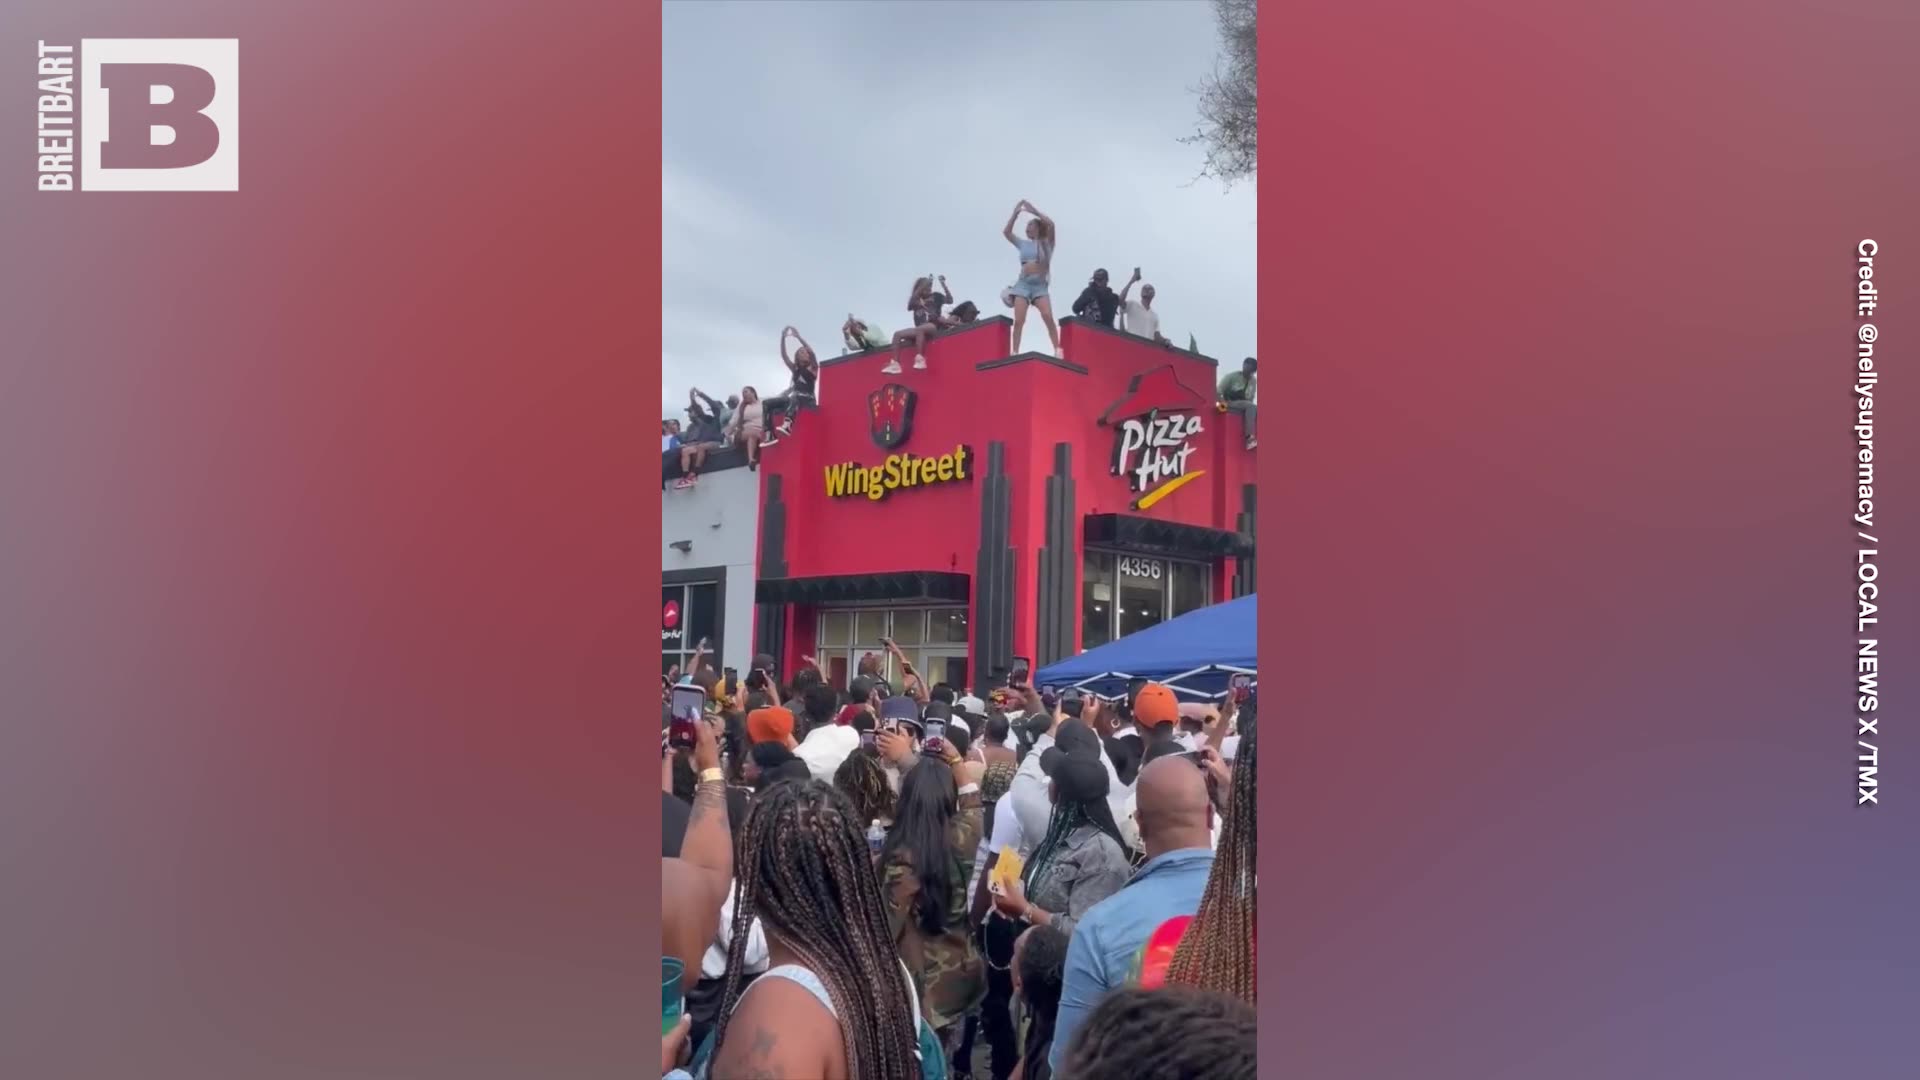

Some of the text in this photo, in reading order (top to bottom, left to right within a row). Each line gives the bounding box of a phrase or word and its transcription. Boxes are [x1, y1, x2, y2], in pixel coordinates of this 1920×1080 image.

[1119, 408, 1205, 476] Pizza
[1135, 441, 1197, 492] Hut
[824, 444, 966, 500] WingStreet
[1121, 557, 1161, 579] 4356
